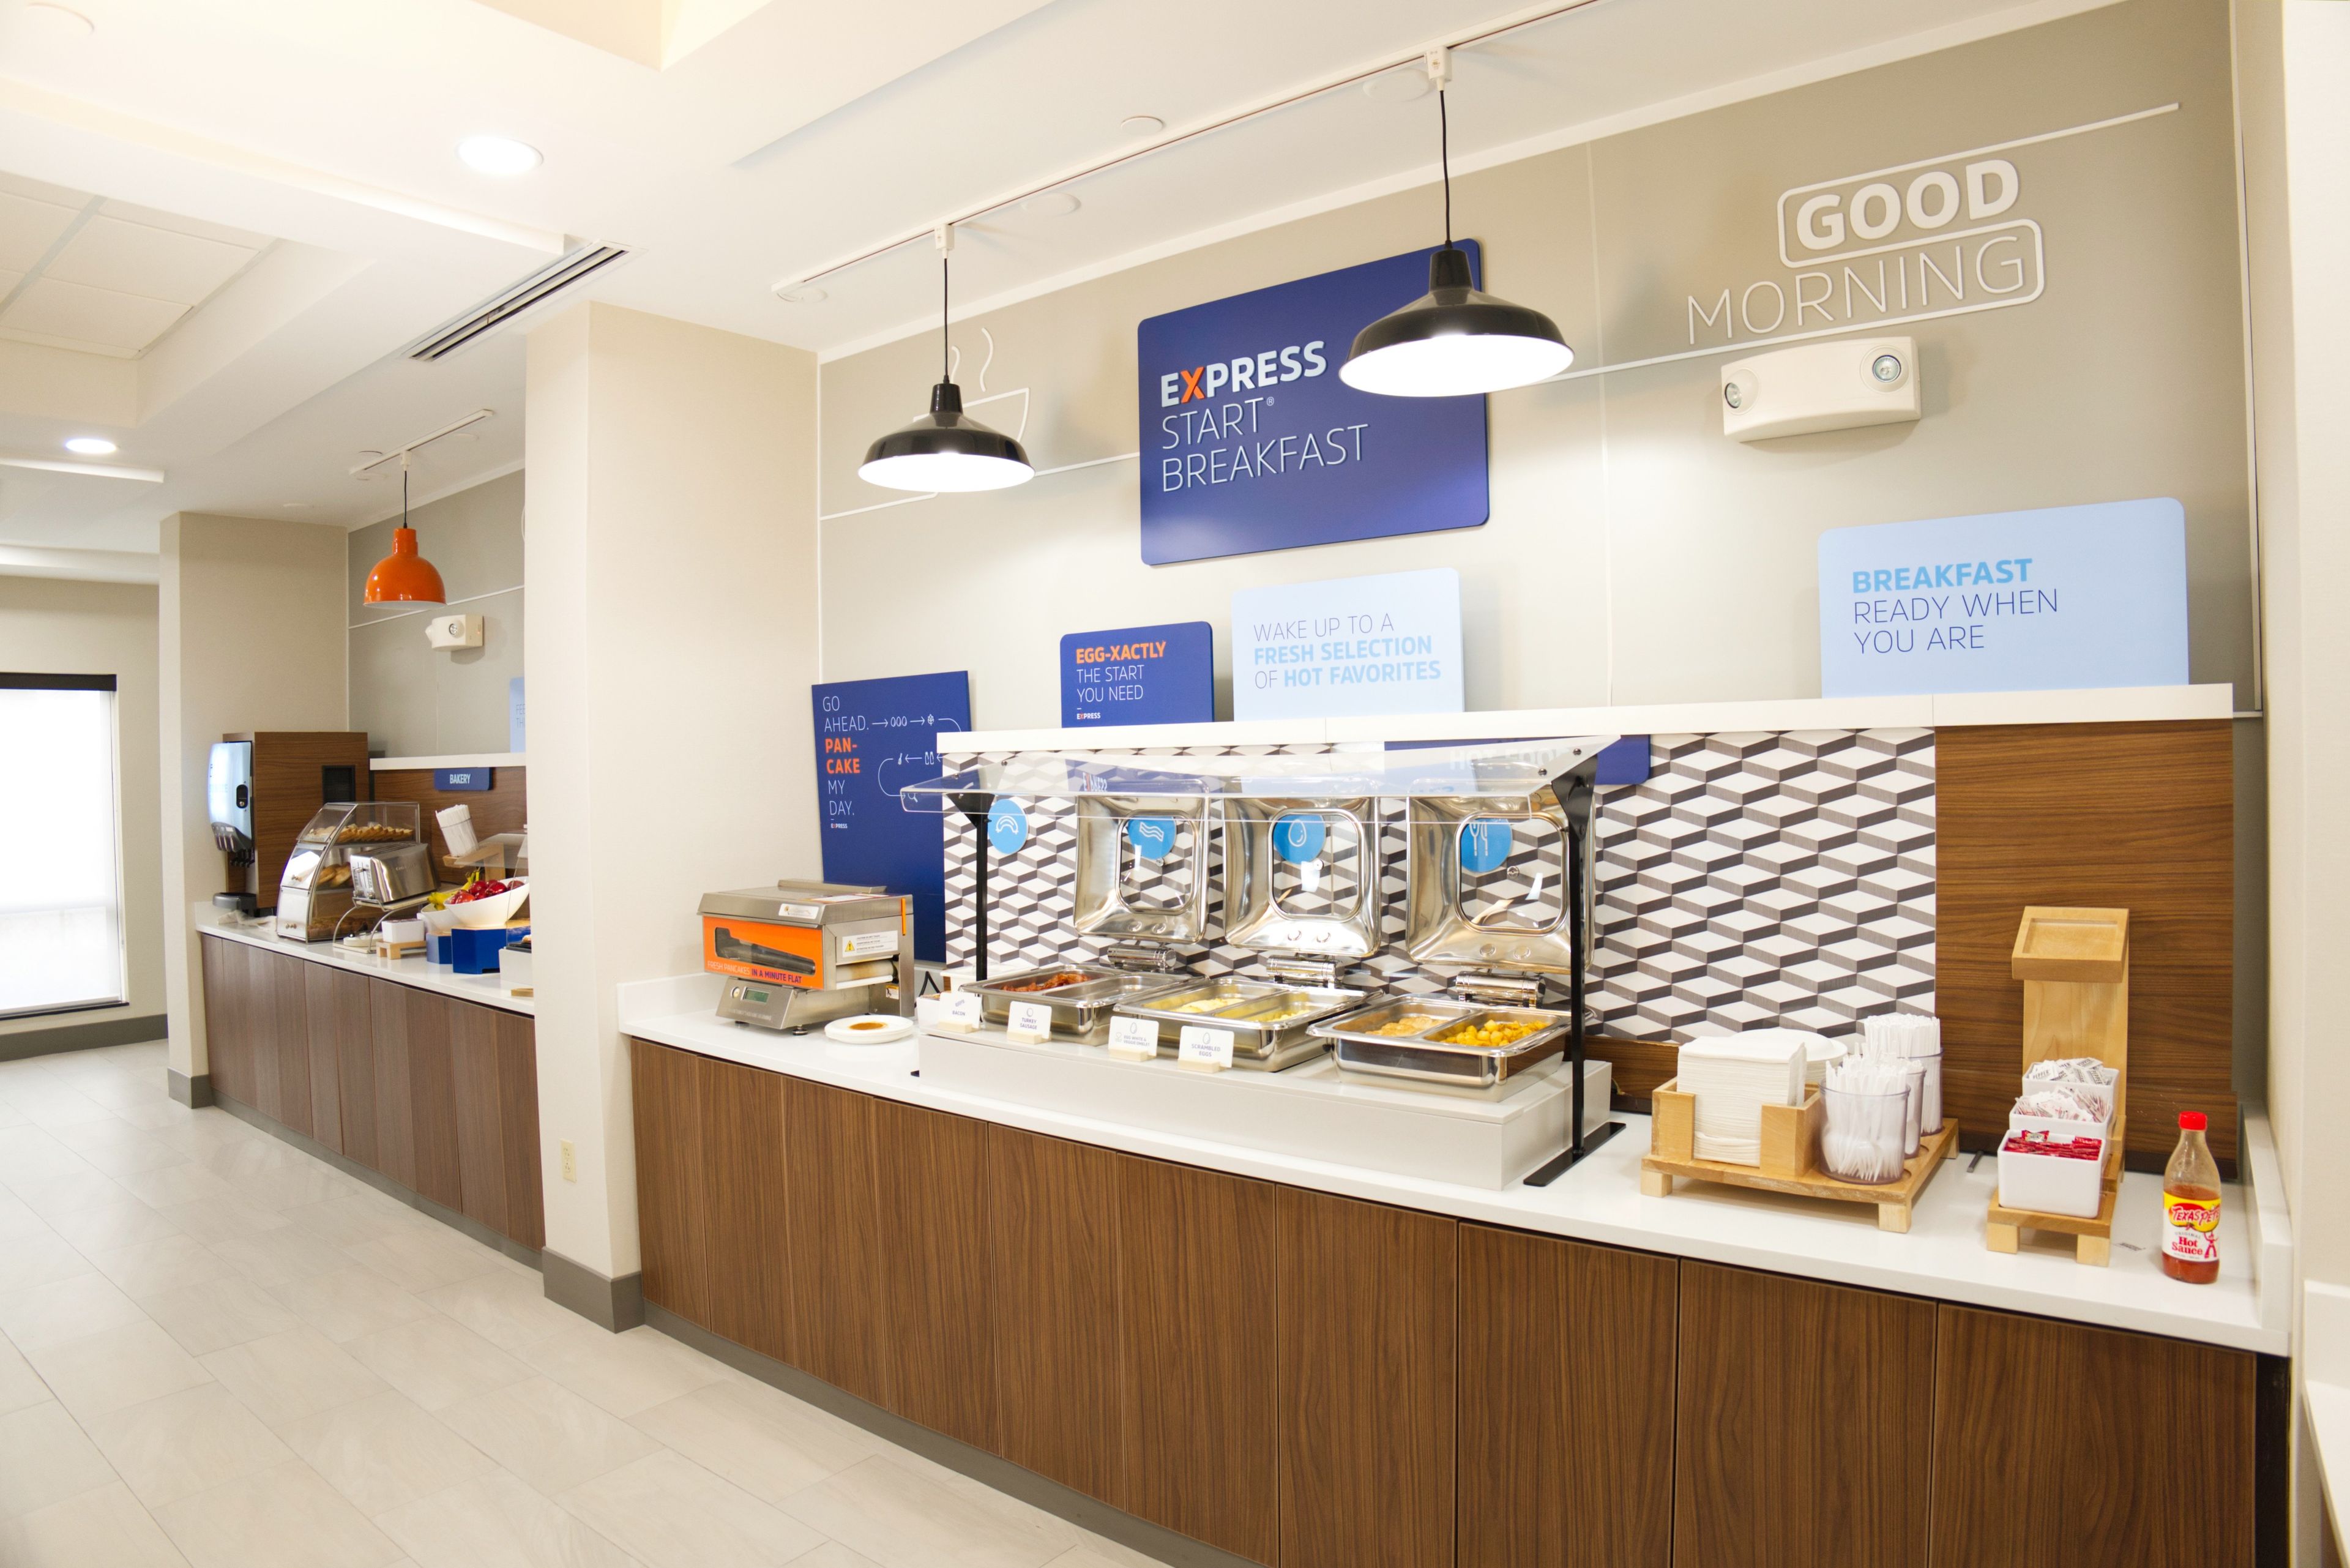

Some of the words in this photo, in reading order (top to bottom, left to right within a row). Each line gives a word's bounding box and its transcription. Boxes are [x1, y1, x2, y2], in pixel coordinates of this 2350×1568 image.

[1796, 159, 2019, 250] GOOD
[1687, 236, 2024, 345] MORNING
[1161, 340, 1327, 407] EXPRESS
[1163, 424, 1368, 492] BREAKFAST
[1852, 558, 2033, 594] BREAKFAST
[1854, 596, 1950, 624] READY
[1961, 588, 2058, 617] WHEN
[1253, 620, 1307, 642] WAKE
[1315, 618, 1340, 637] UP
[1348, 614, 1373, 635] TO
[1381, 613, 1394, 632] A
[1854, 629, 1914, 654] YOU
[1927, 625, 1985, 651] ARE
[1076, 641, 1166, 664] EGG-XACTLY
[1254, 644, 1313, 665] FRESH
[1321, 635, 1431, 661] SELECTION
[1076, 668, 1100, 683] THE
[1105, 665, 1144, 682] START
[1255, 670, 1278, 689] OF
[1285, 667, 1322, 687] HOT
[1330, 660, 1441, 685] FAVORITES
[822, 695, 840, 712] GO
[1077, 687, 1103, 703] YOU
[1109, 685, 1143, 701] NEED
[824, 715, 869, 733] AHEAD.
[825, 737, 857, 753] PAN-
[826, 758, 860, 774] CAKE
[1450, 749, 1498, 771] HOT
[450, 774, 471, 784] BAKERY
[828, 780, 845, 795] MY
[829, 801, 854, 816] DAY.
[707, 960, 723, 970] FRESH
[724, 963, 750, 975] PANCAKES
[765, 971, 786, 981] MINUTE
[788, 974, 802, 984] FLAT
[1192, 1043, 1221, 1052] SCRAMBLED
[2171, 1205, 2200, 1222] TEXAS
[2172, 1241, 2203, 1255] Sauce
[2179, 1236, 2198, 1247] Hot
